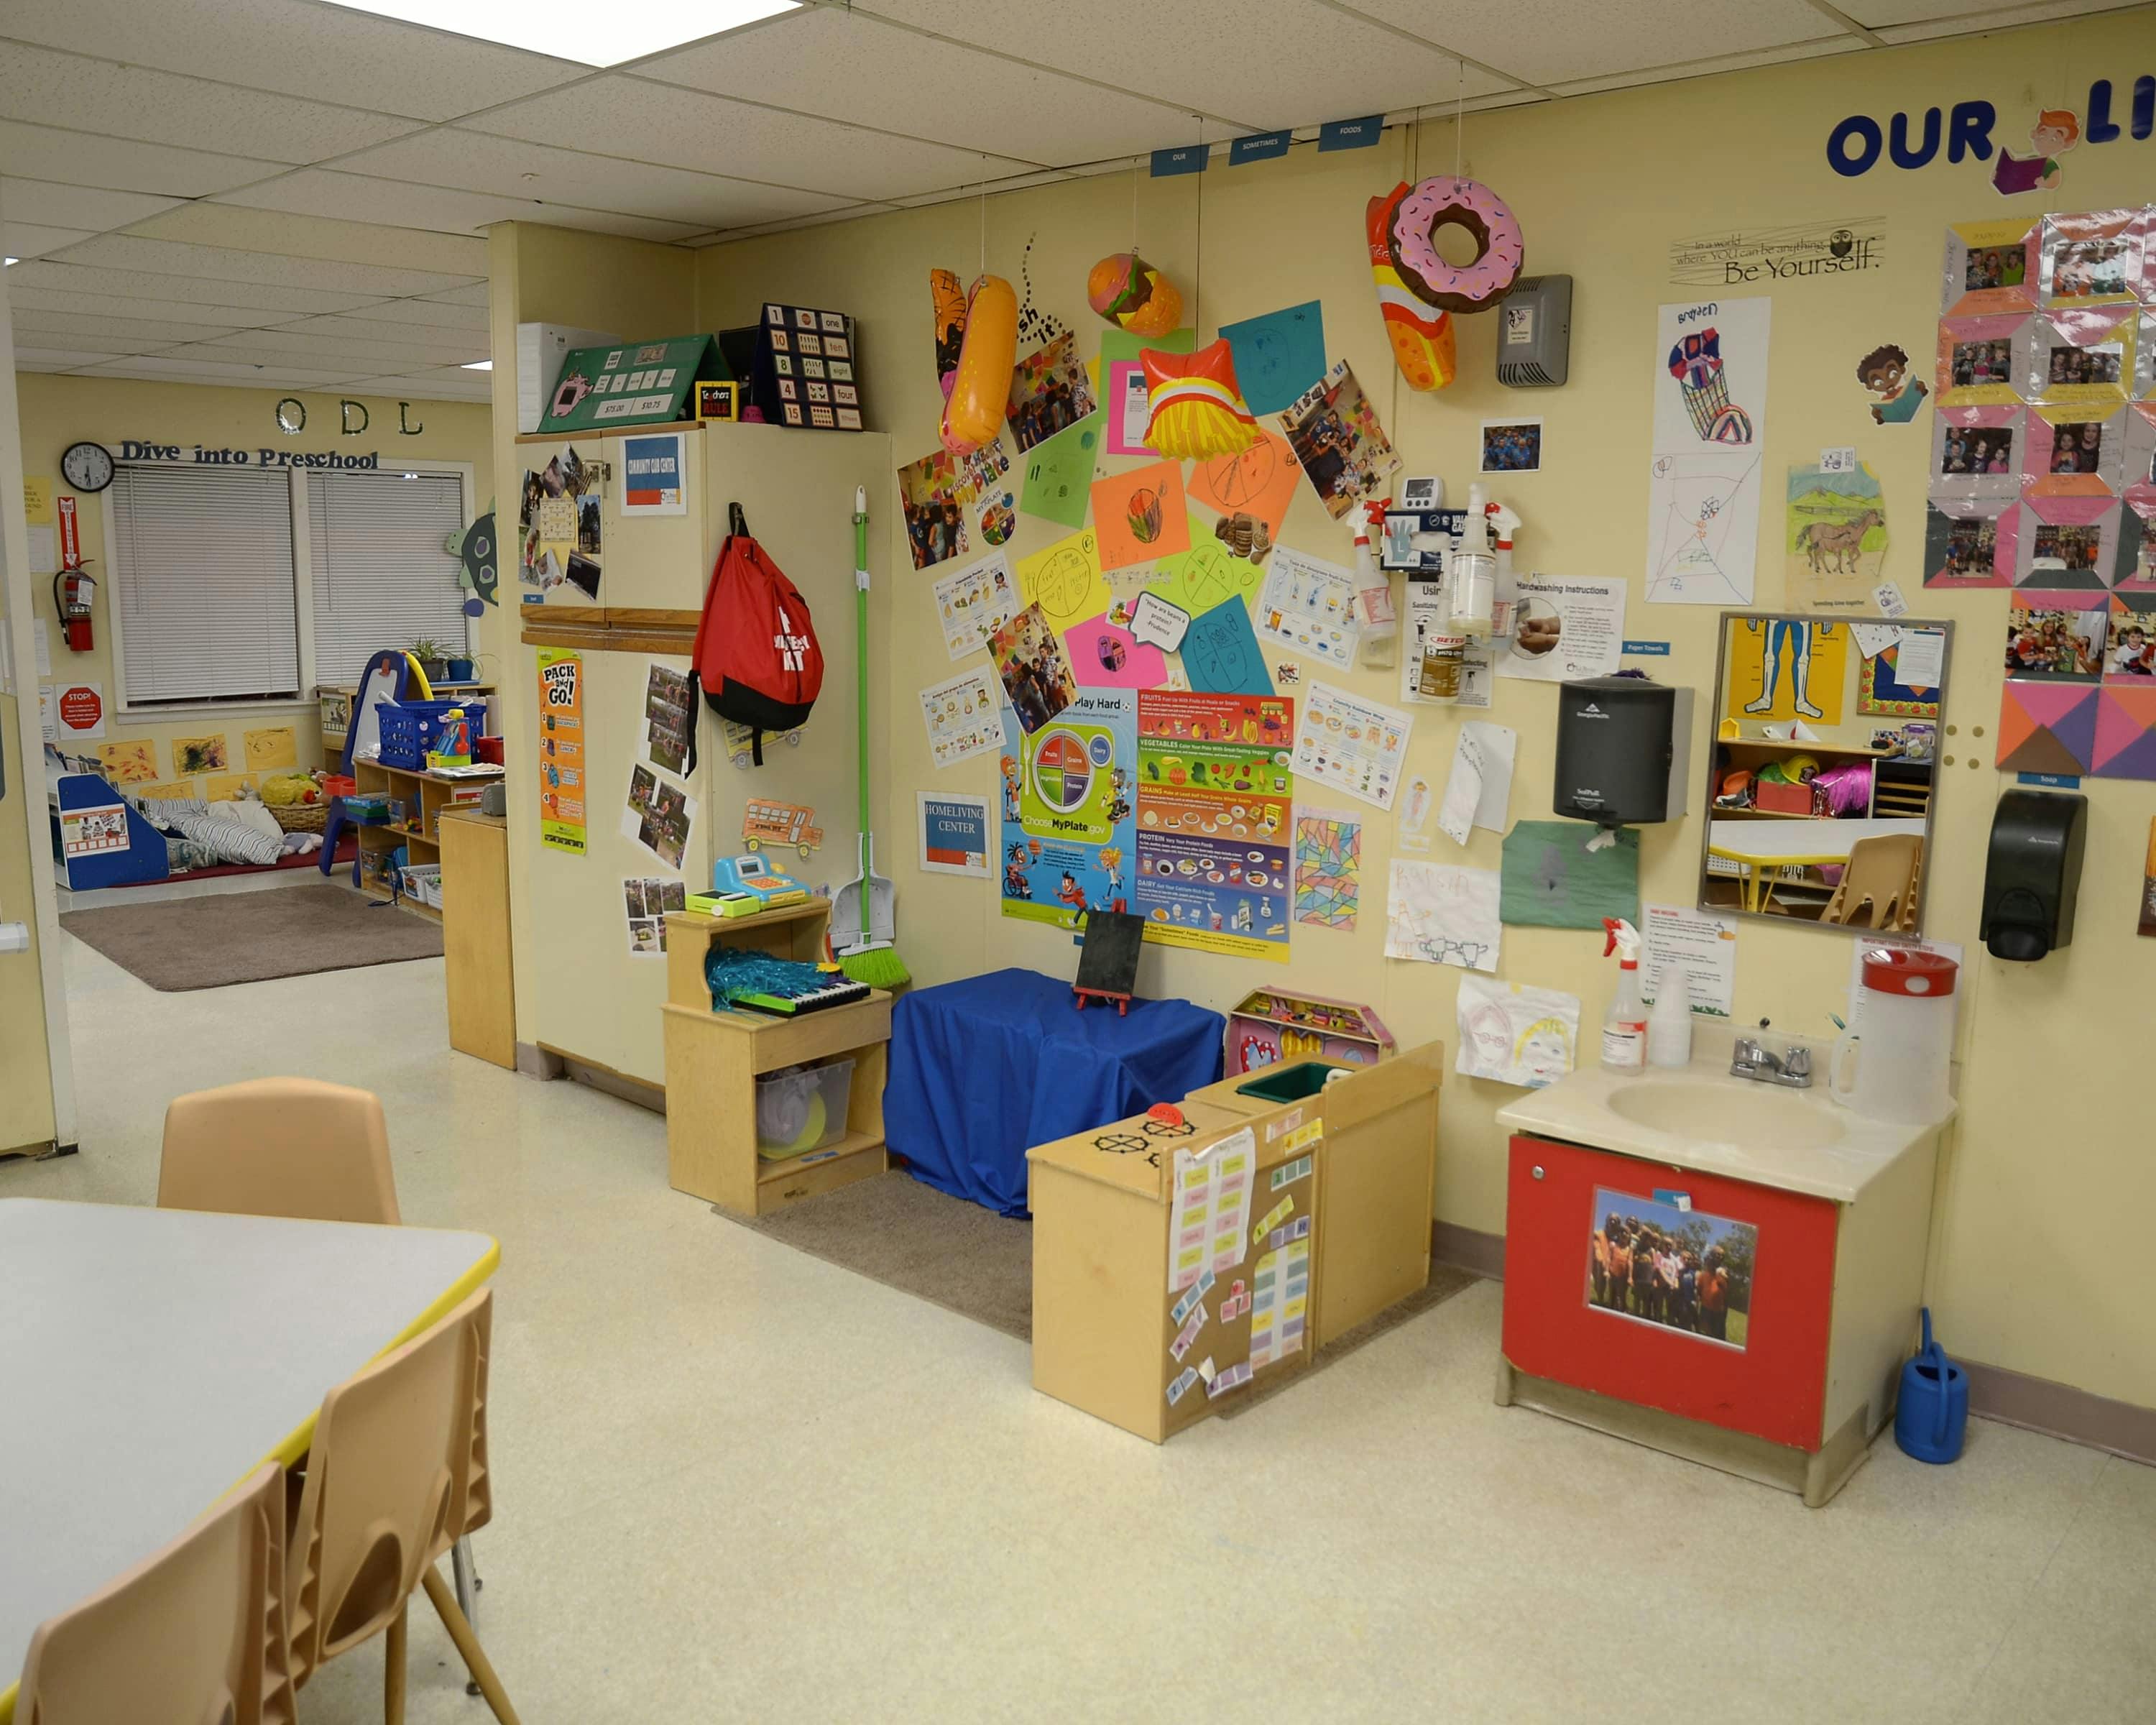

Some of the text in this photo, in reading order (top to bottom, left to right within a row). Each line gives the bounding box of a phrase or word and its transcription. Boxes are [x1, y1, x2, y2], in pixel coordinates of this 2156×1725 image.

[1826, 75, 2156, 178] OUR LI
[1243, 139, 1278, 150] SOMETIMES
[1340, 126, 1362, 135] FOODS
[1712, 234, 1741, 249] world
[1677, 252, 1706, 265] where
[1710, 250, 1737, 260] YOU
[1740, 248, 1759, 257] can
[1761, 242, 1774, 254] be
[1725, 261, 1759, 284] Be
[773, 310, 778, 321] 1
[826, 318, 840, 328] one
[1038, 323, 1056, 344] it
[775, 334, 786, 346] 10
[829, 343, 843, 352] ten
[780, 359, 787, 370] 8
[833, 367, 848, 376] eight
[785, 384, 791, 395] 4
[838, 389, 853, 400] four
[604, 400, 661, 414] $75.00 $10.75
[703, 402, 729, 414] RULE
[788, 408, 798, 418] 15
[341, 400, 369, 436] D
[121, 441, 379, 469] Dive into Preschool
[1398, 541, 1405, 553] L
[1565, 584, 1609, 595] Instructions
[544, 665, 576, 682] PACK
[68, 693, 91, 702] STOP!
[549, 681, 574, 705] GO!
[1141, 694, 1161, 702] FRUITS
[1075, 696, 1120, 710] Play Hard
[1140, 740, 1178, 748] VEGETABLES
[2041, 775, 2058, 783] Soap
[926, 804, 984, 819] HOMELIVING
[938, 820, 975, 834] CENTER
